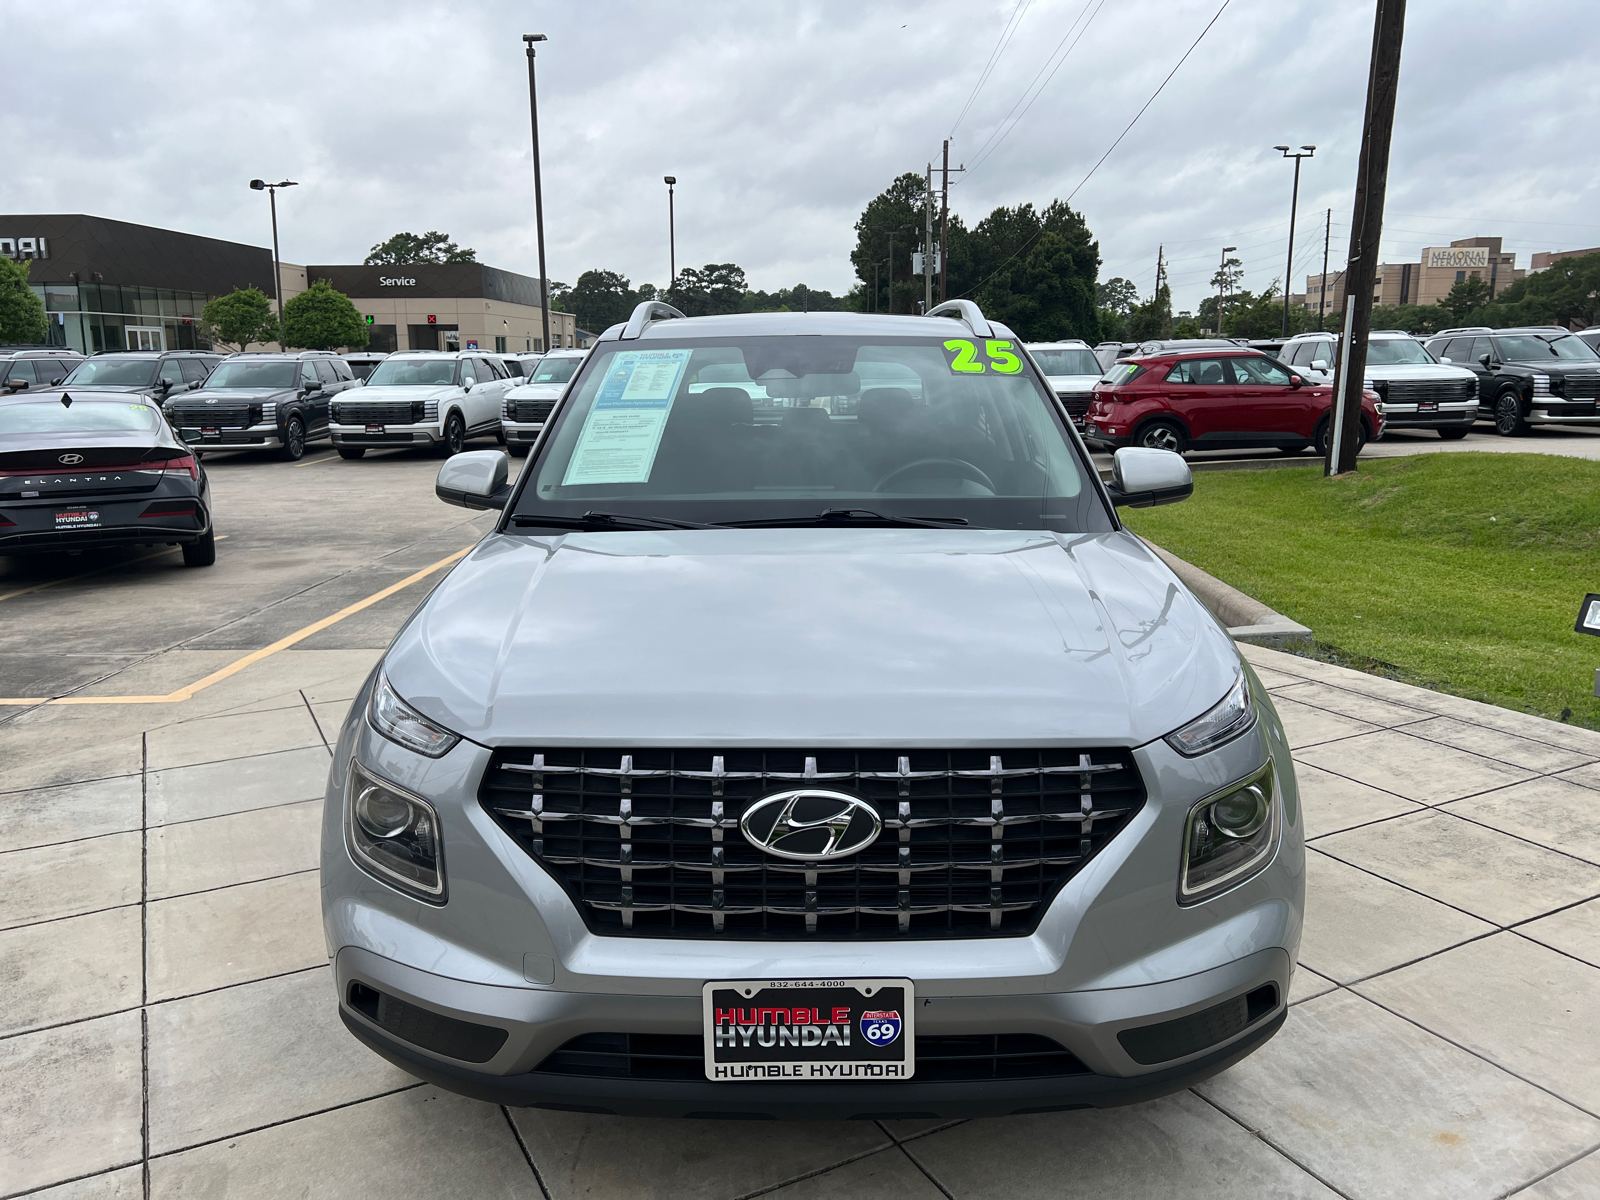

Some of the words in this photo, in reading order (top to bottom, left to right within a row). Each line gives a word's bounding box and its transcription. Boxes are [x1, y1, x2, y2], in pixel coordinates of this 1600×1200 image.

[1431, 257, 1485, 267] HERMANN
[1432, 250, 1486, 260] MEMORIAL
[380, 276, 416, 286] Service
[943, 339, 1024, 375] 25
[24, 476, 121, 484] ELANTRA
[715, 1007, 851, 1025] HUMBLE
[715, 1025, 851, 1047] HYUNDAI
[867, 1023, 895, 1040] 69
[714, 1065, 803, 1078] HUMBLE
[810, 1064, 905, 1077] HYUNDAI
